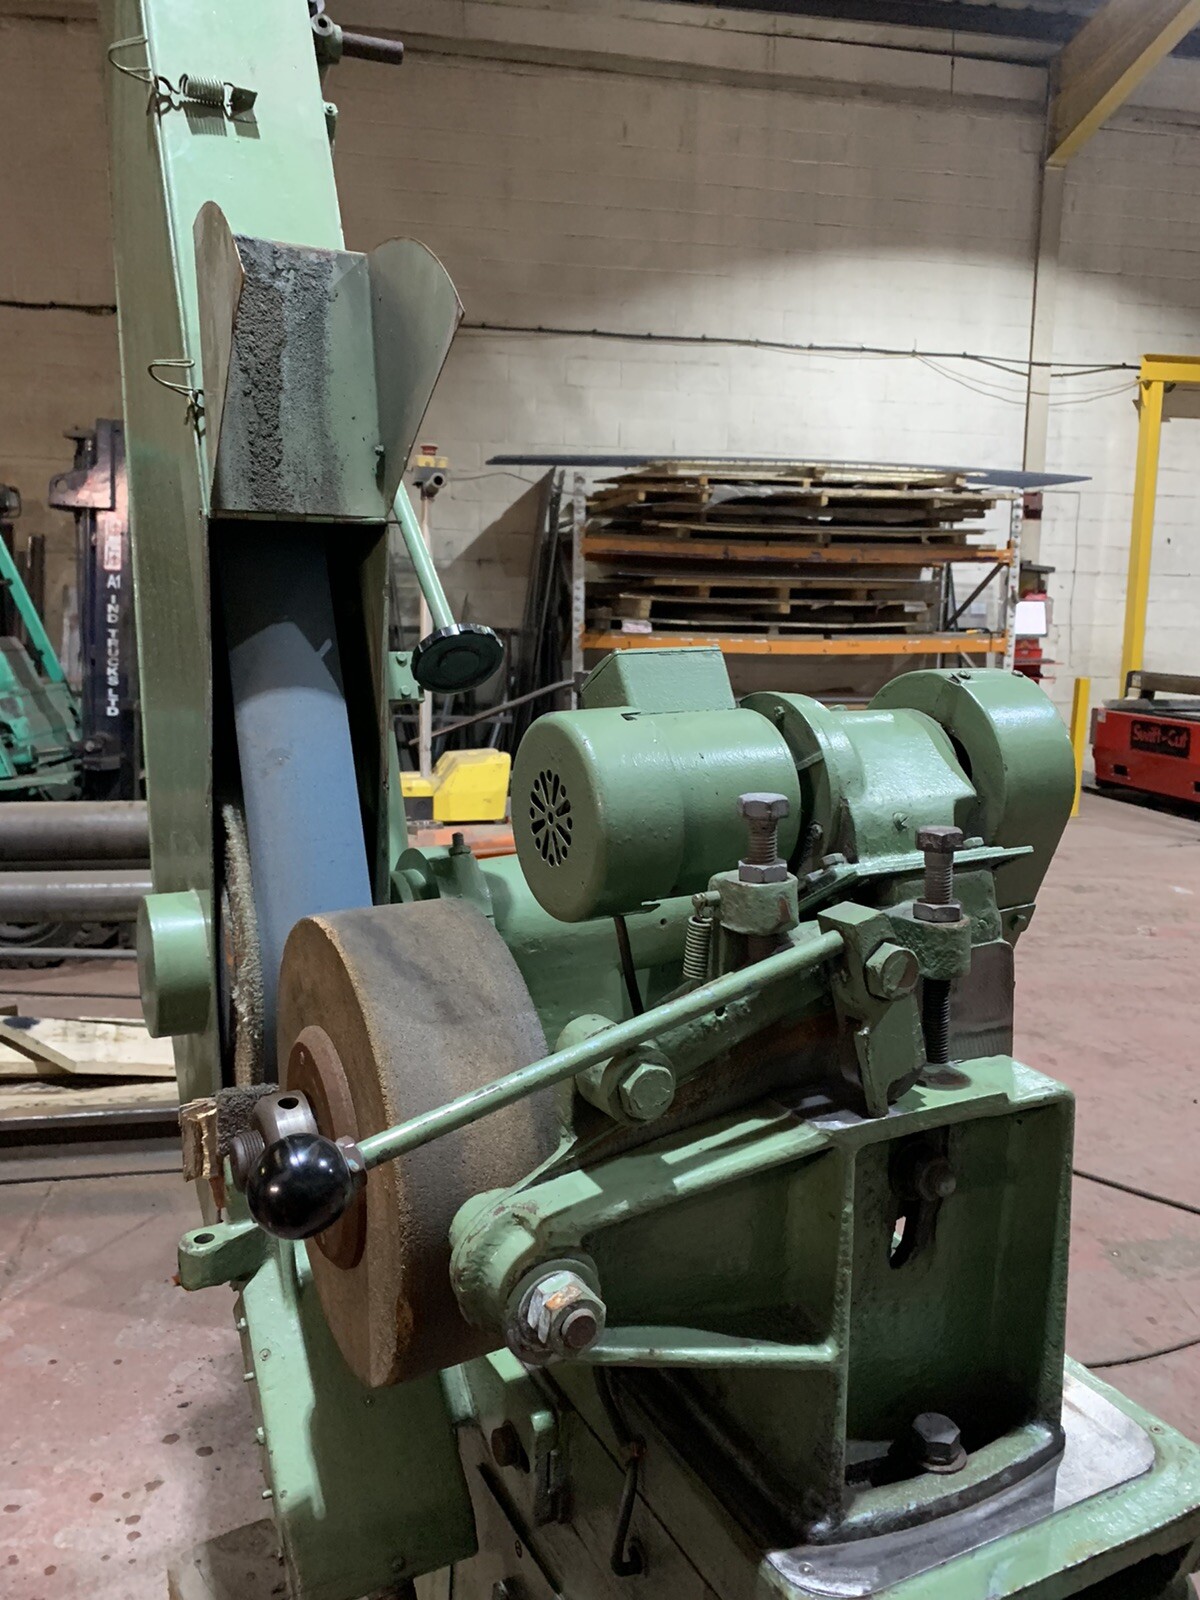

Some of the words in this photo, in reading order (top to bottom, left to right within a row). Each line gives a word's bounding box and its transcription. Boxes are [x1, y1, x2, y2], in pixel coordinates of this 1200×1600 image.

[107, 574, 121, 589] A1
[107, 594, 119, 623] IND
[107, 629, 119, 686] TRUCKS
[106, 688, 119, 716] LTD
